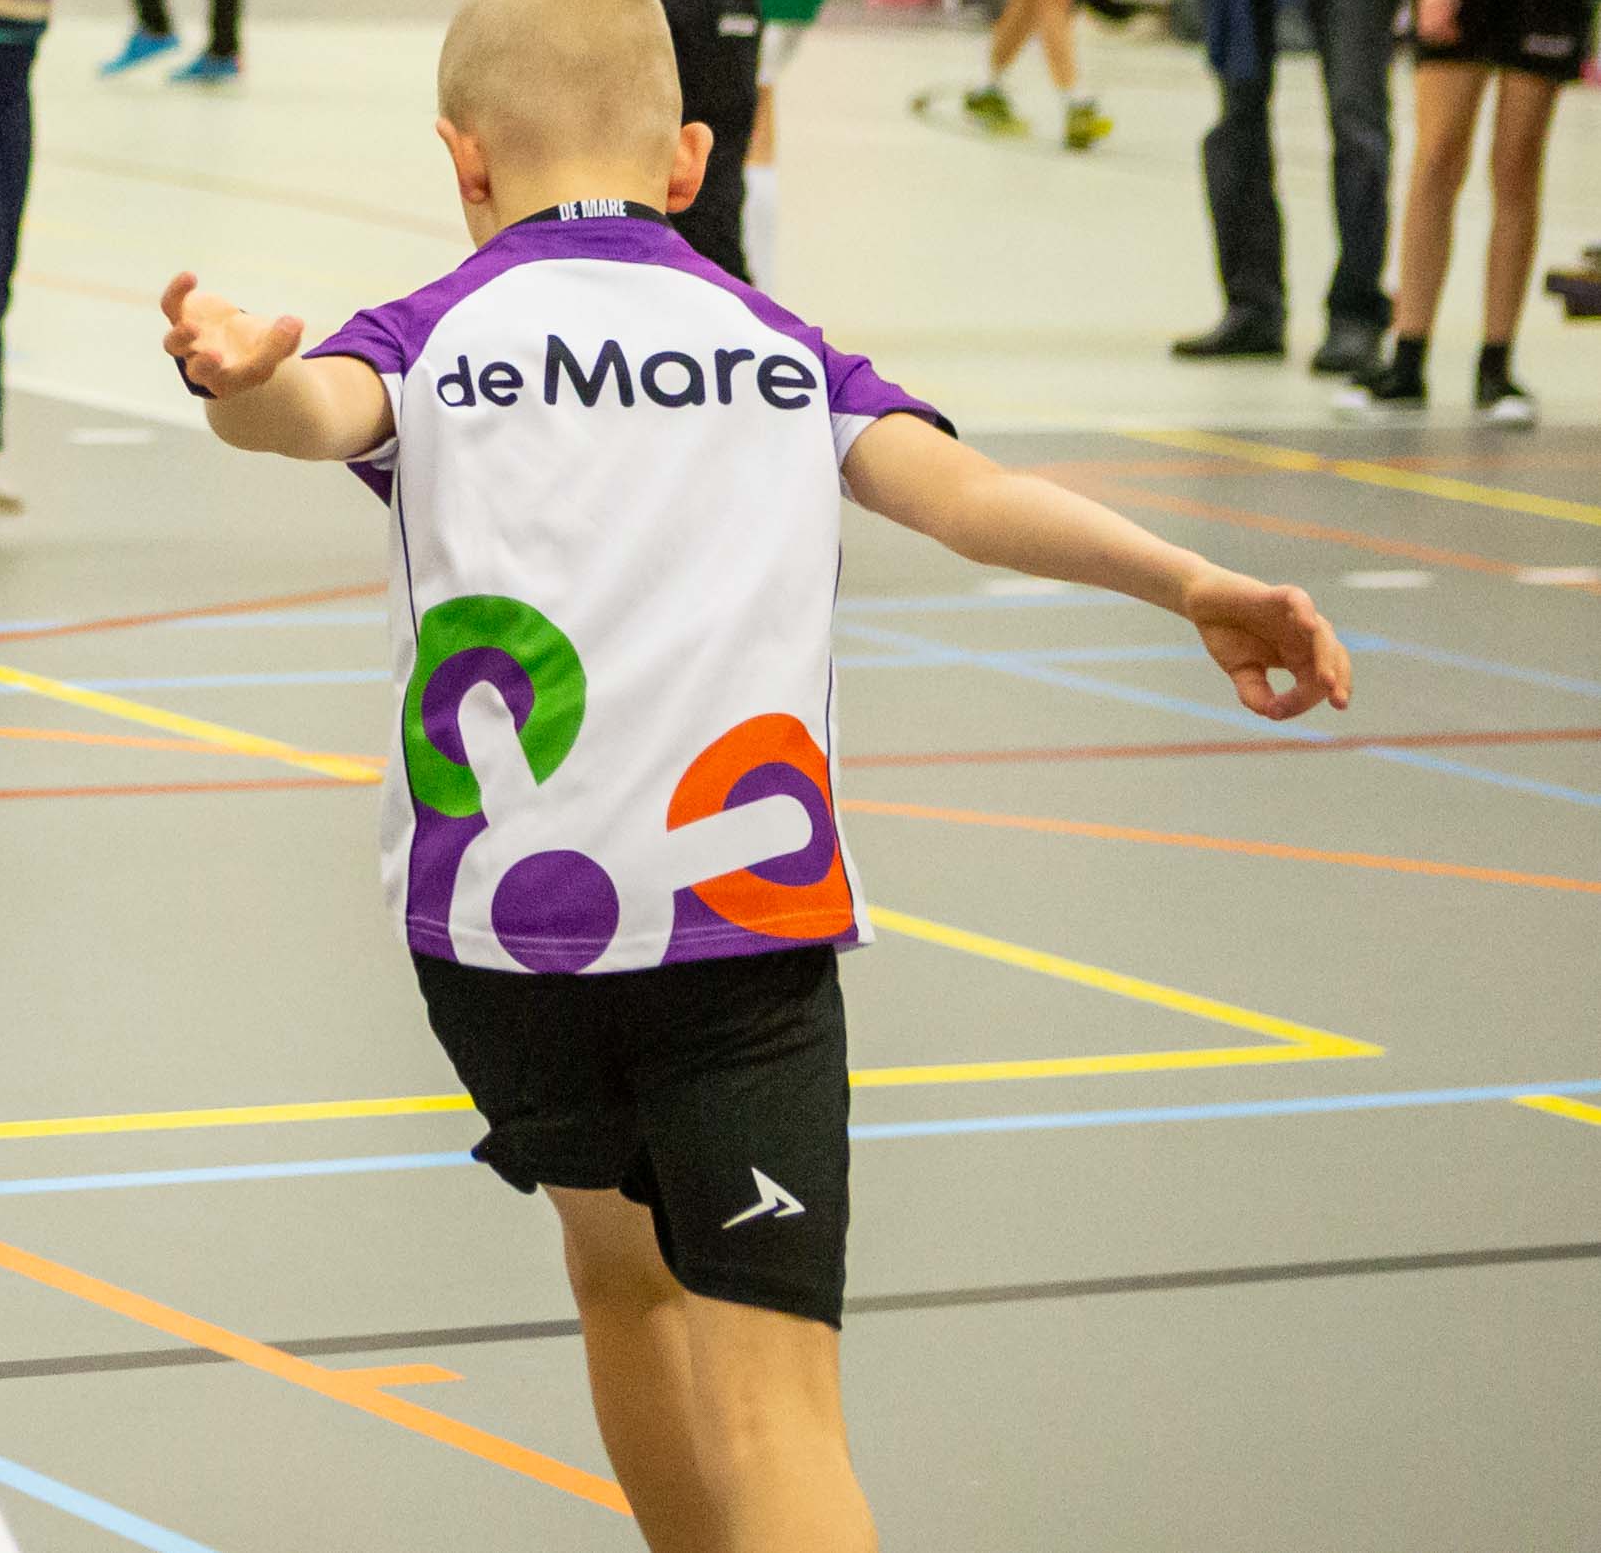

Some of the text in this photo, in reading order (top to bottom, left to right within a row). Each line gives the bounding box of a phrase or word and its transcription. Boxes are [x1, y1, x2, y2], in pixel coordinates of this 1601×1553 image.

[558, 199, 627, 222] DE MARE
[436, 334, 817, 410] de Mare
